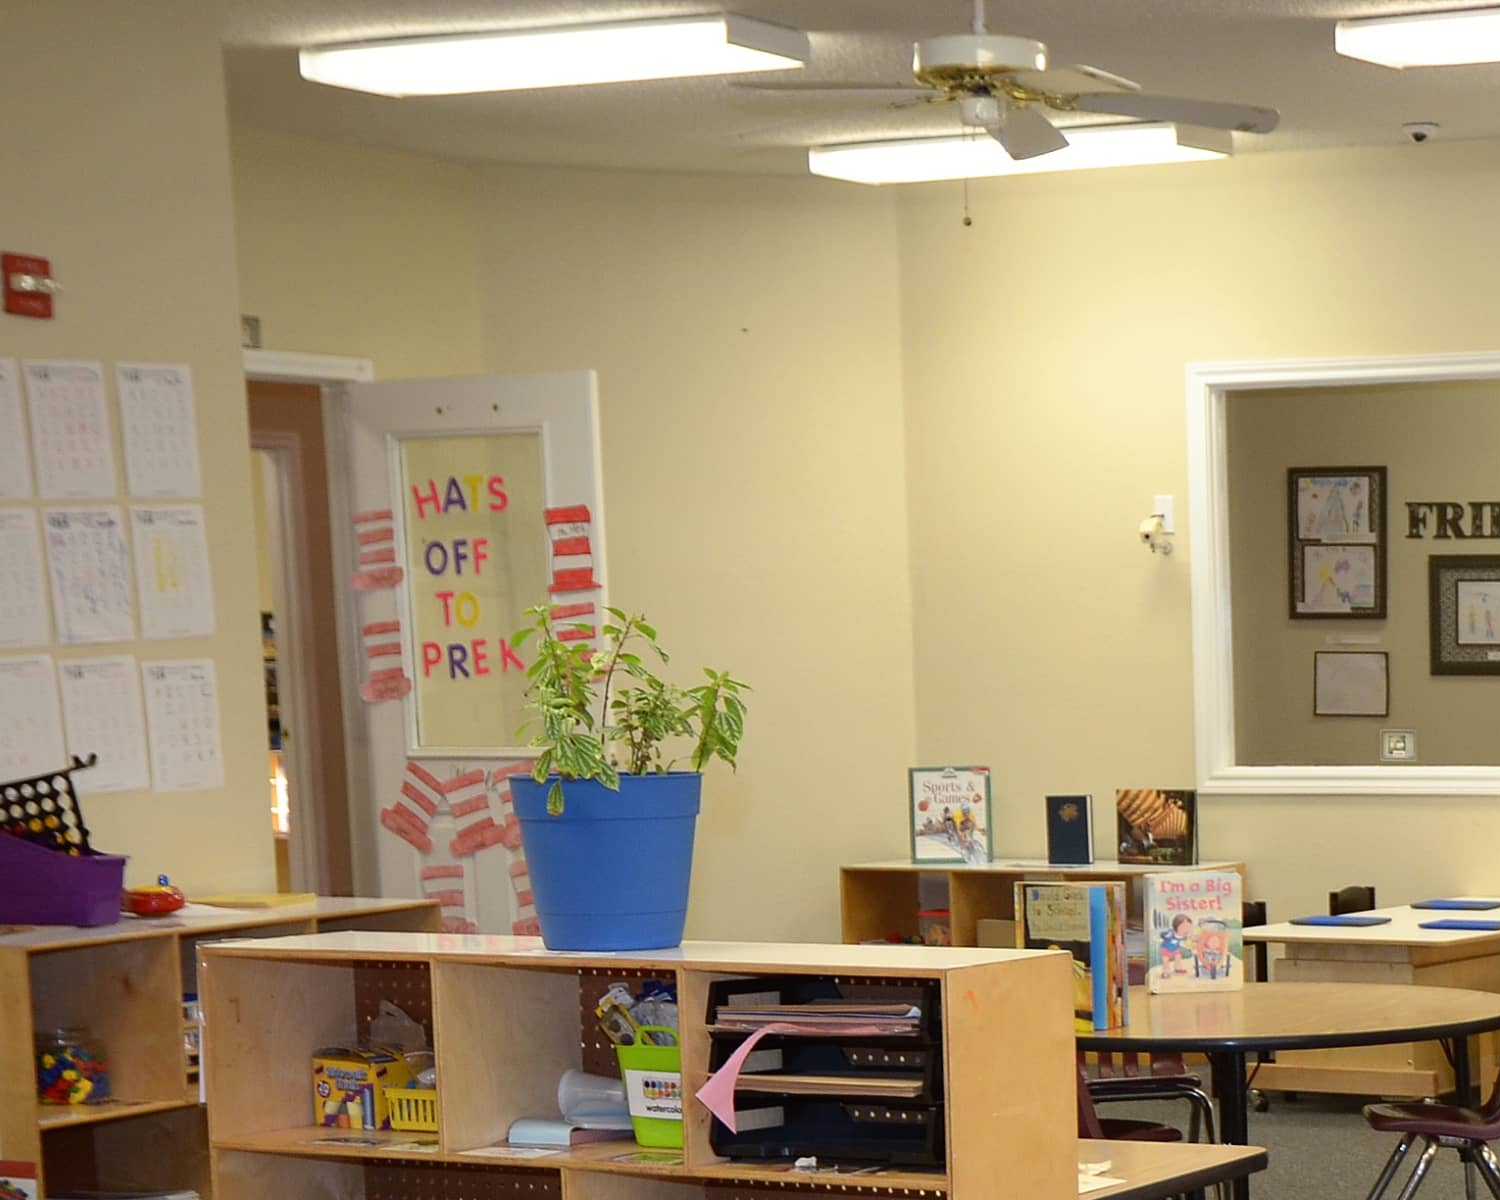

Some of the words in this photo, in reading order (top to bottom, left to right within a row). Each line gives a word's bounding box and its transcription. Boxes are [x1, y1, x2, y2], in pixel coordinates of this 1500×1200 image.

[411, 475, 509, 520] HATS
[424, 539, 489, 576] OFF
[435, 591, 480, 628] TO
[922, 780, 962, 794] Sports
[966, 781, 976, 792] &
[933, 793, 970, 804] Games
[1160, 880, 1185, 893] I'm
[1190, 882, 1200, 893] a
[1206, 878, 1233, 896] Big
[1166, 896, 1223, 911] Sister!
